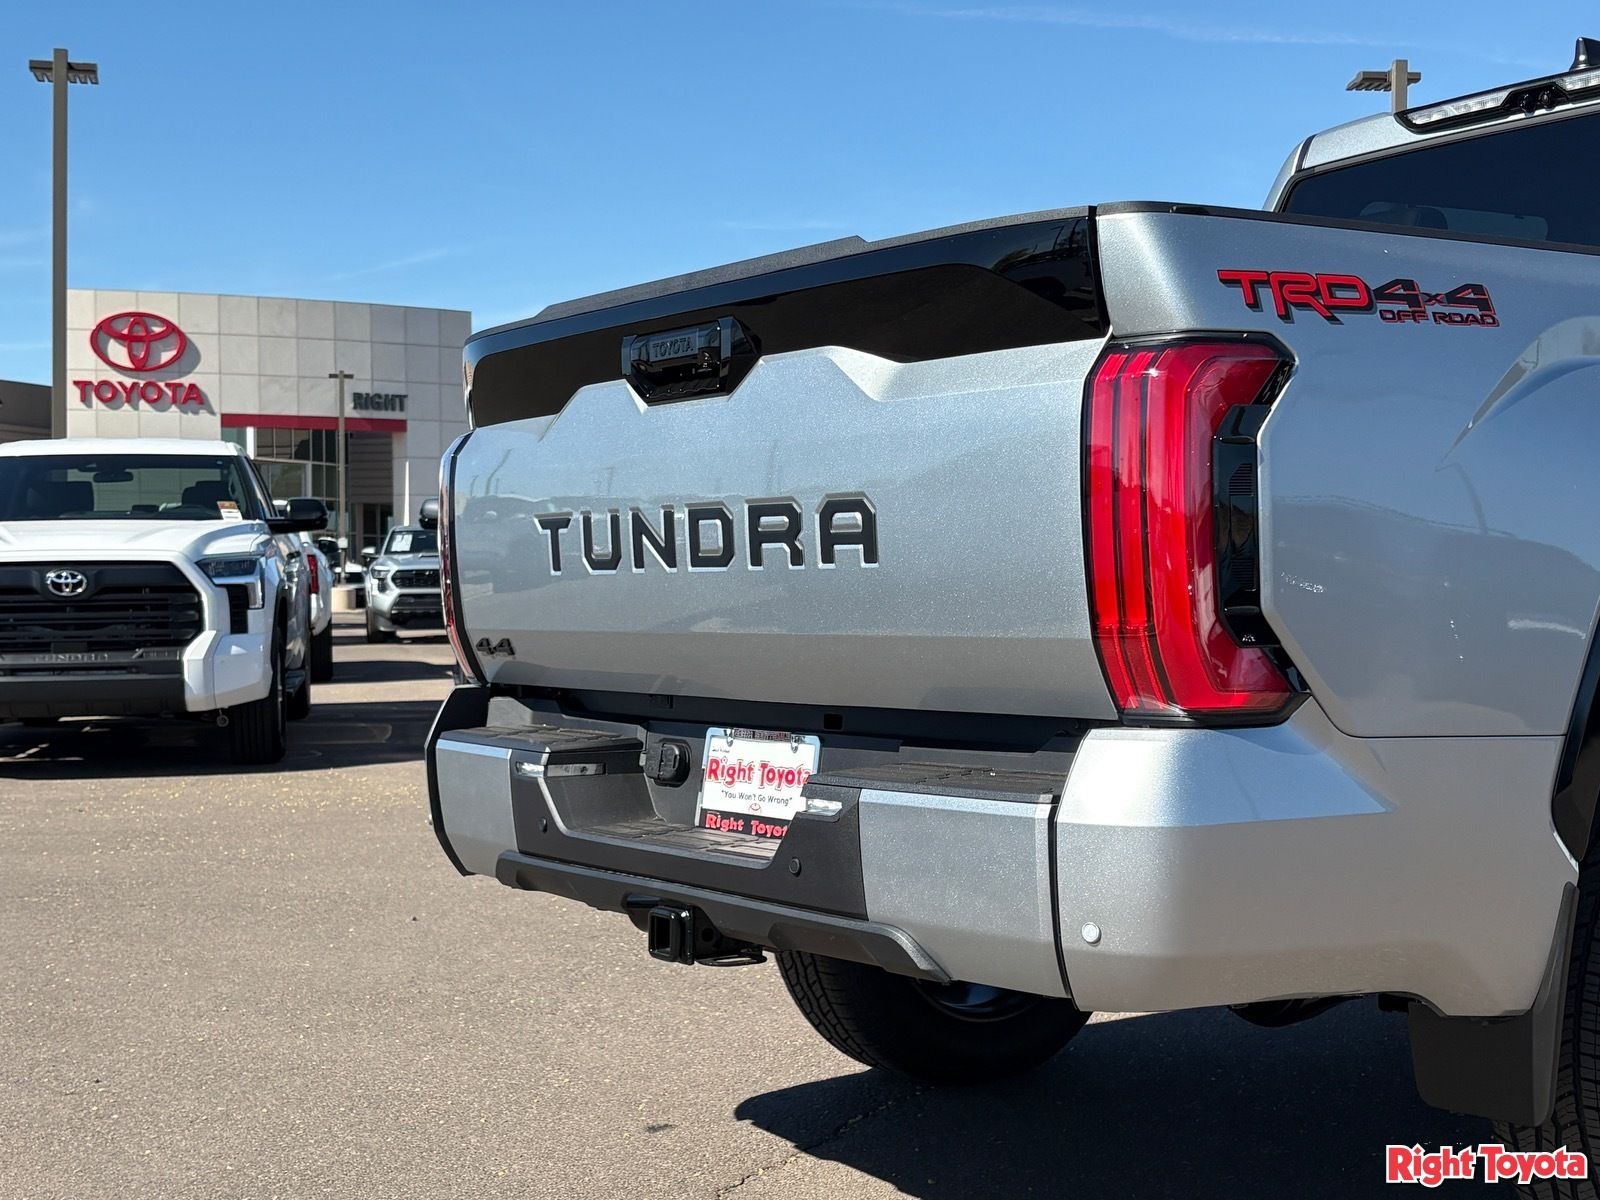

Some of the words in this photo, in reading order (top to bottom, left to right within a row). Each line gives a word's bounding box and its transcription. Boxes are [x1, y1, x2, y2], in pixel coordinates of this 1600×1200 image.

[1217, 269, 1377, 325] TRD
[1379, 308, 1429, 324] OFF
[1432, 311, 1500, 327] ROAD
[652, 336, 694, 357] TOYOTA
[73, 380, 204, 404] TOYOTA
[352, 391, 408, 412] RIGHT
[534, 491, 879, 576] TUNDRA
[706, 755, 756, 788] Right
[757, 793, 766, 802] Go
[704, 813, 745, 833] Right
[750, 820, 788, 838] Toyot
